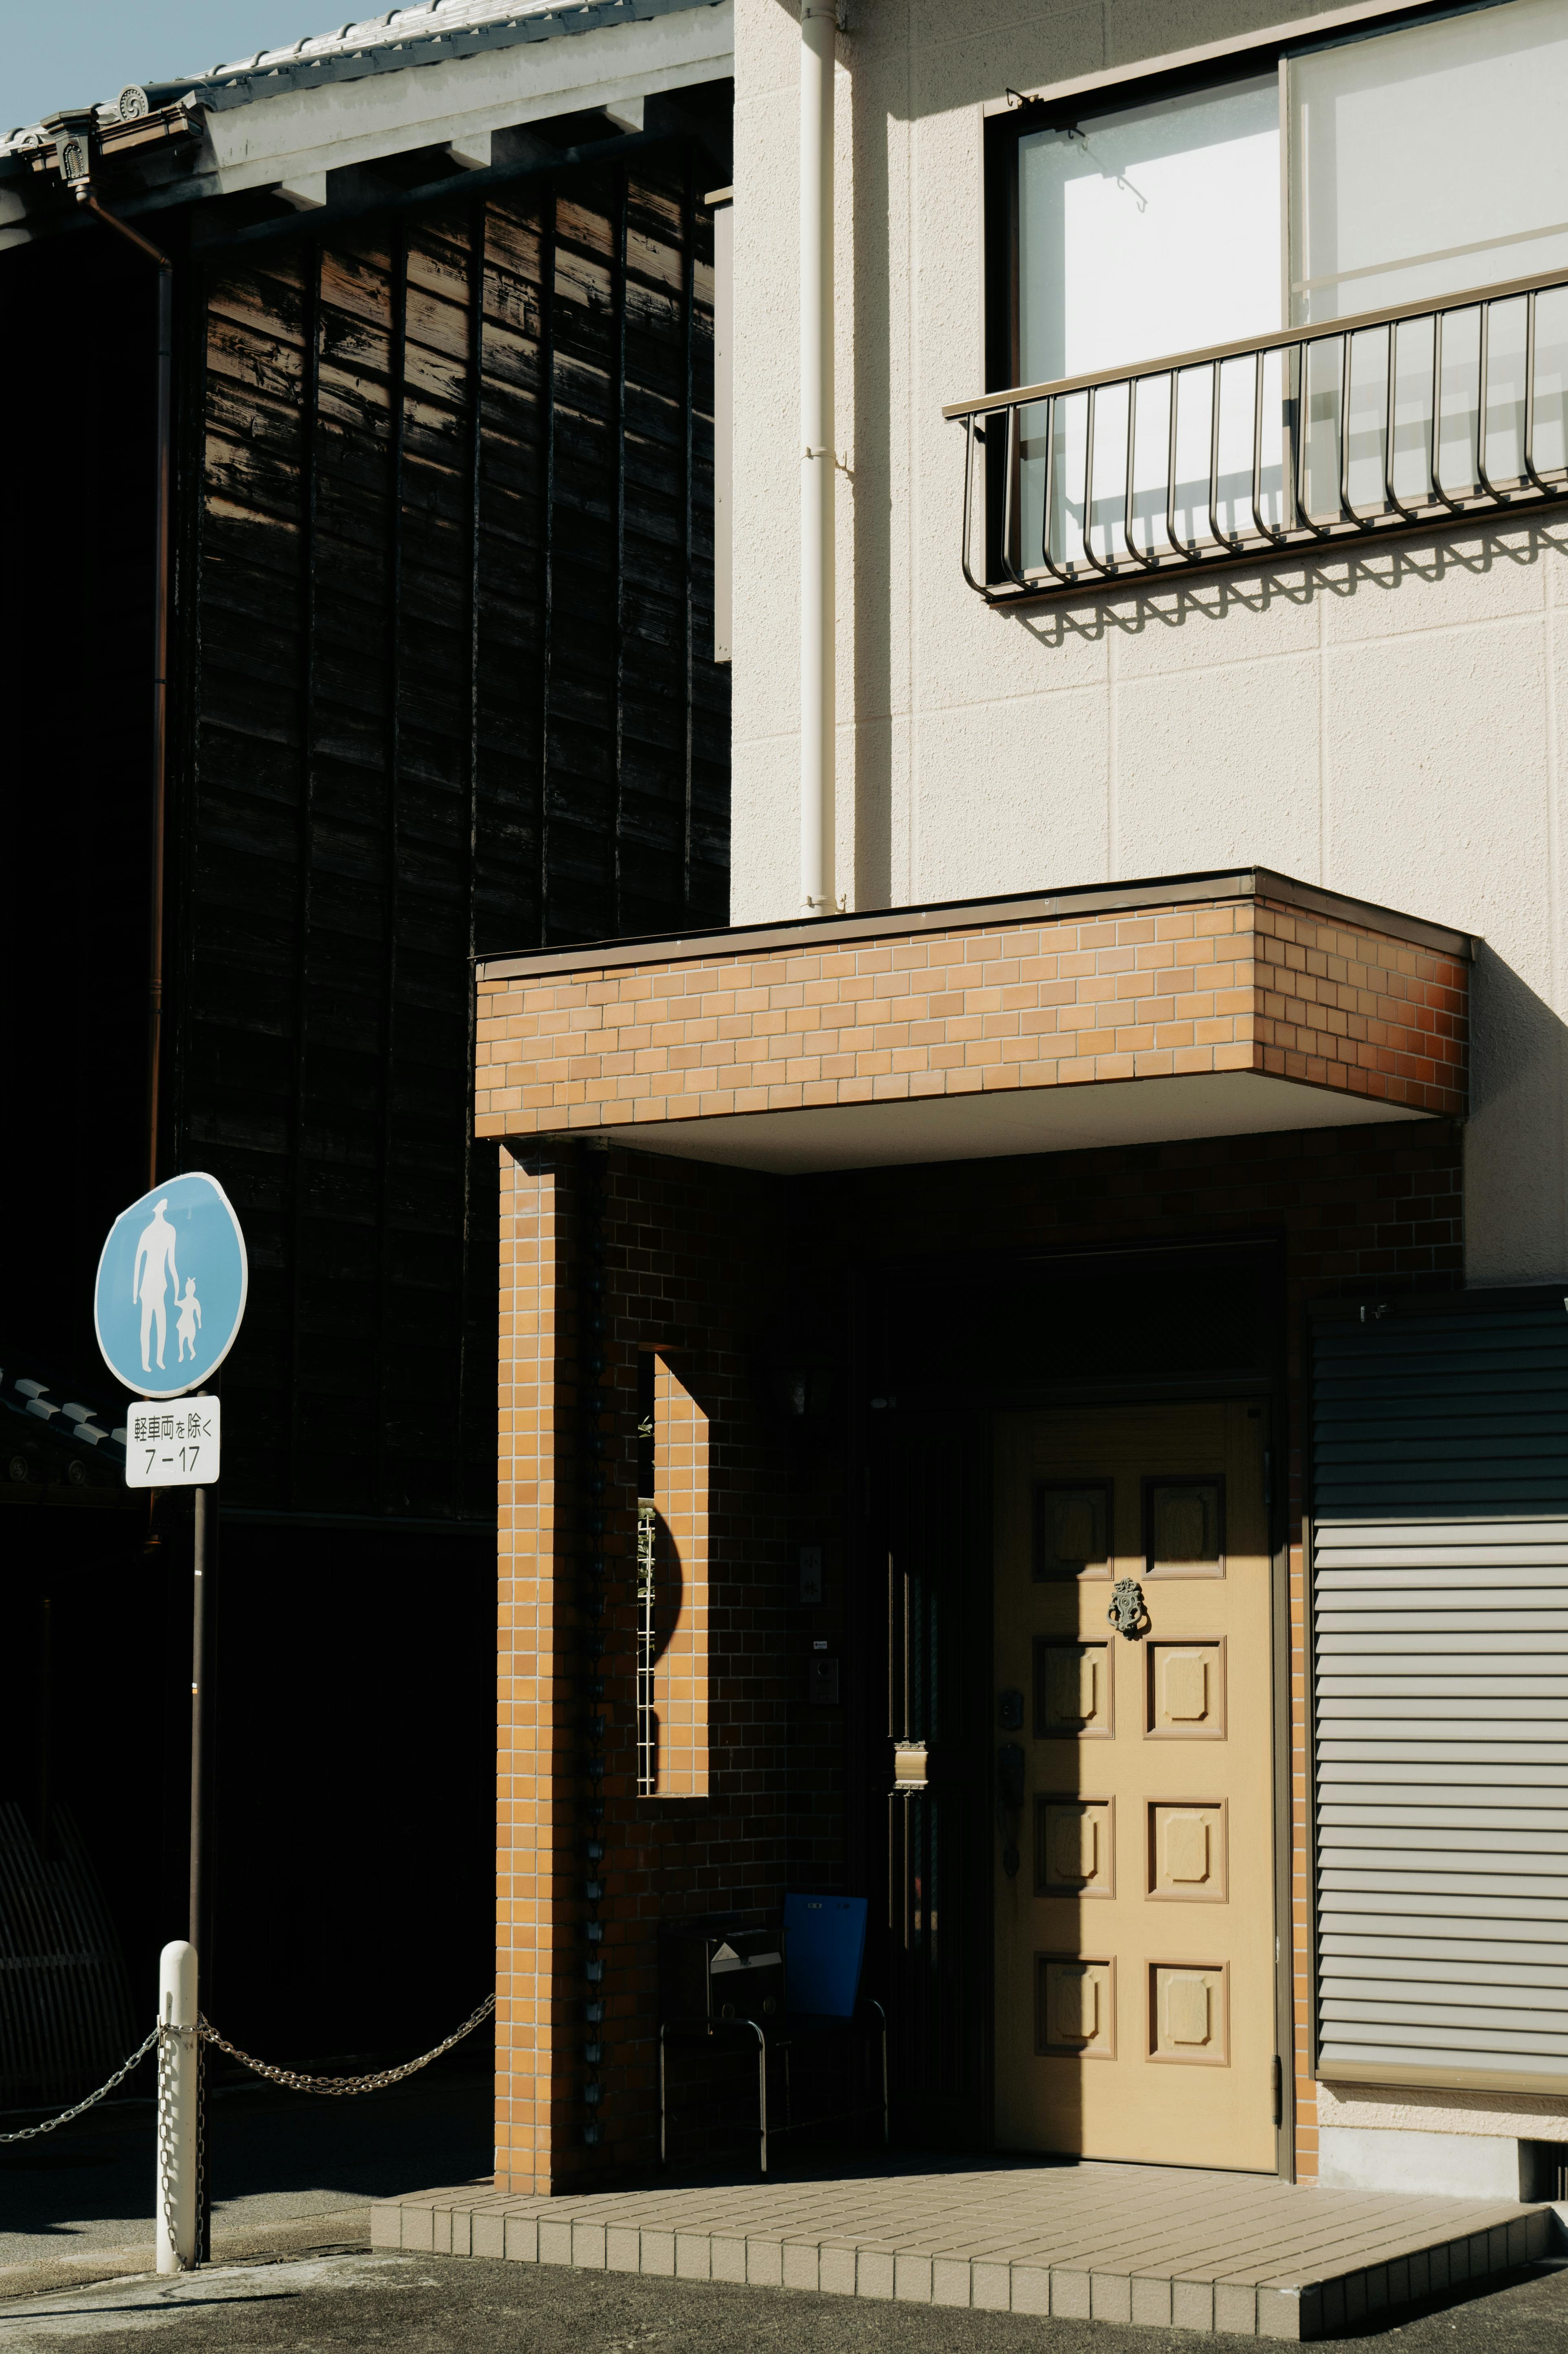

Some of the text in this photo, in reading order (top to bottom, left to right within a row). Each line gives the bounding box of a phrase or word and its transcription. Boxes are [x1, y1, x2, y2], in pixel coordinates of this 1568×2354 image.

[134, 1413, 211, 1442] 軽車両を除く
